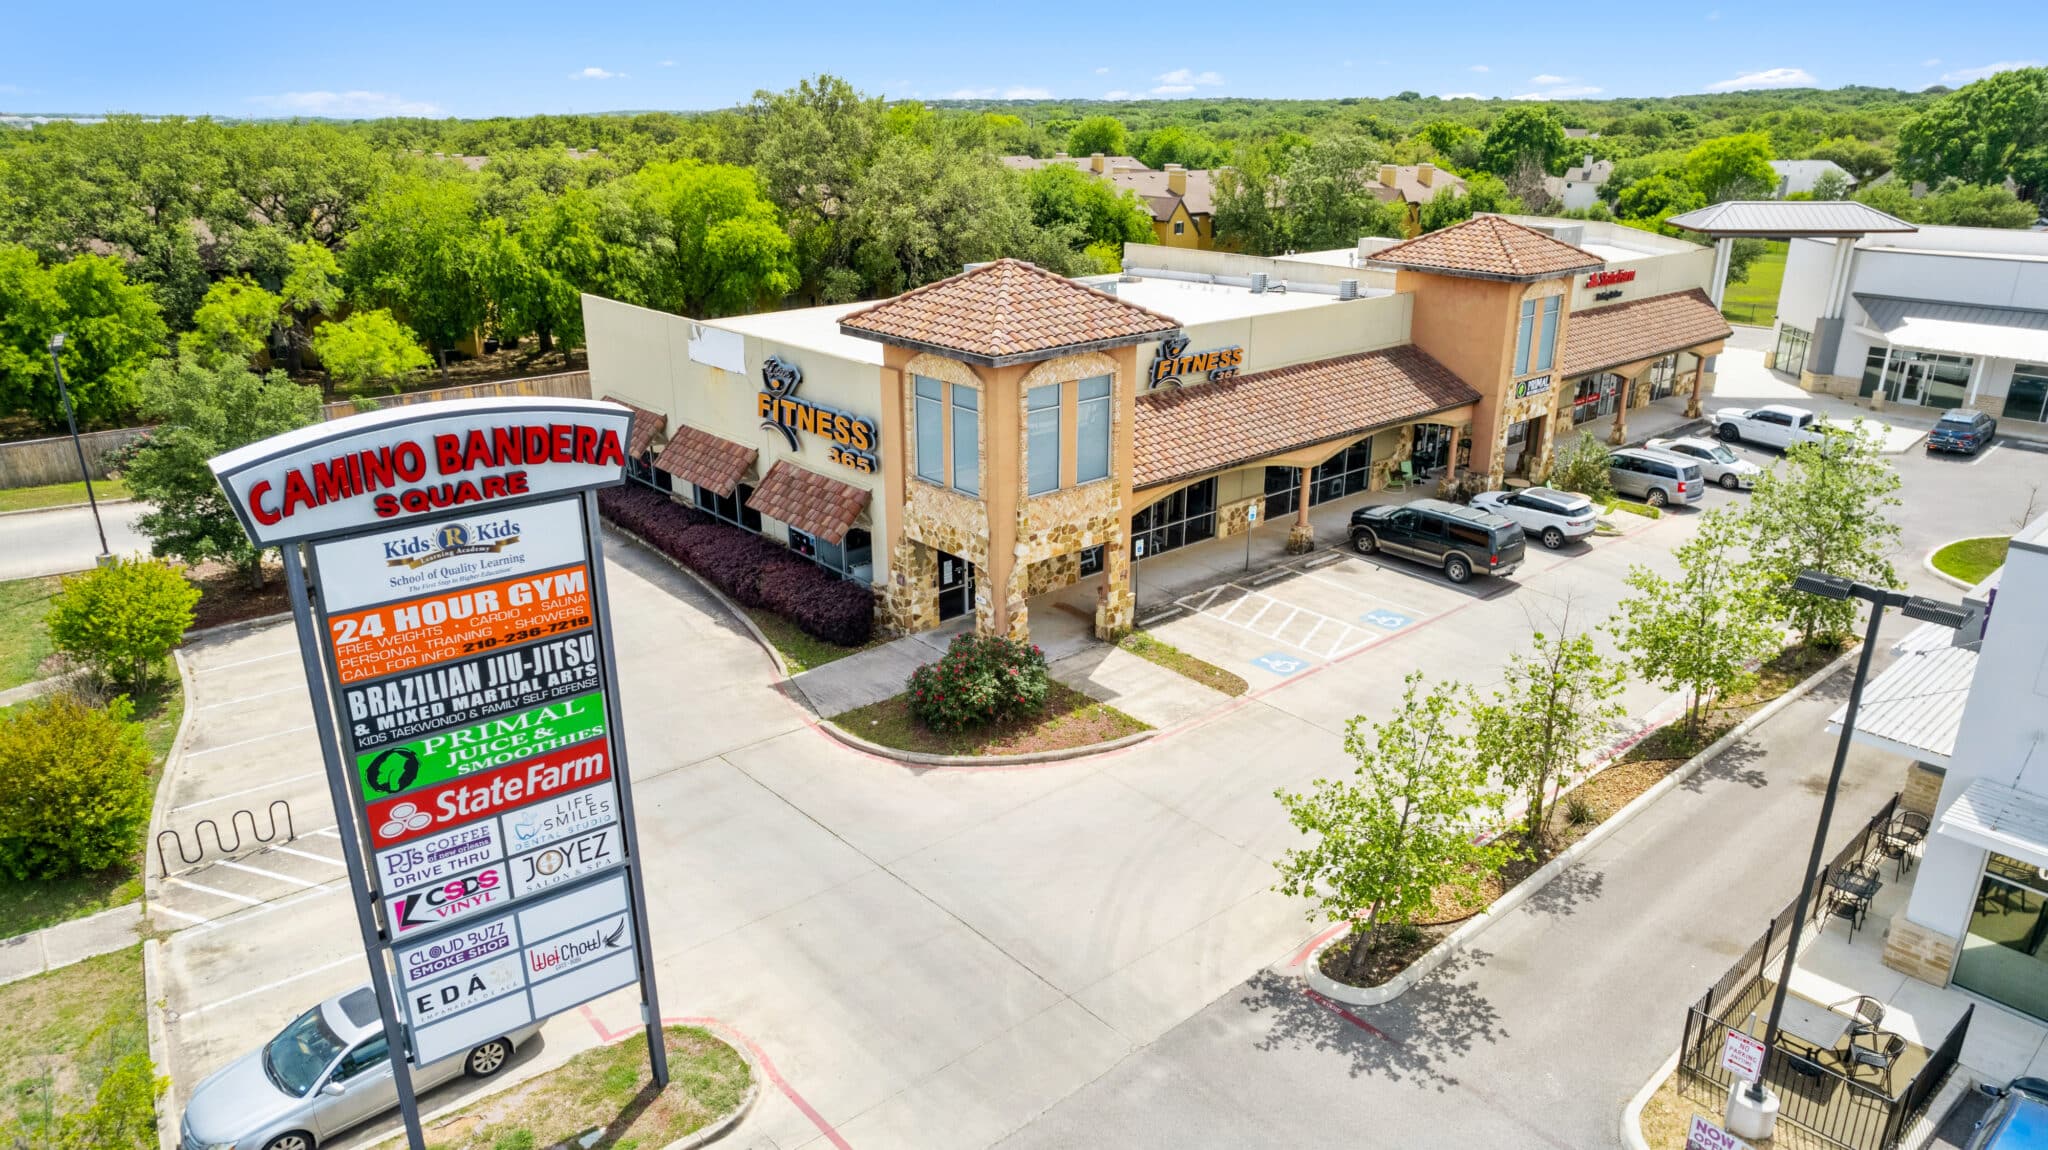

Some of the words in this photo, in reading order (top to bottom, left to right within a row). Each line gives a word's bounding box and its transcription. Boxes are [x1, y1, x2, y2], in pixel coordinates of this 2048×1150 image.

[1157, 347, 1244, 380] FITNESS
[758, 391, 869, 451] FITNESS
[248, 440, 427, 526] CAMINO
[434, 424, 625, 477] BANDERA
[827, 447, 871, 474] 365
[374, 471, 529, 518] SQUARE
[383, 536, 430, 559] Kids
[444, 526, 464, 548] R
[477, 520, 520, 541] Kids
[420, 550, 455, 564] Learning
[389, 571, 425, 588] School
[427, 569, 438, 581] of
[440, 563, 478, 578] Quality
[480, 553, 526, 570] Learning
[333, 613, 385, 645] 24
[393, 590, 500, 633] HOUR
[507, 571, 586, 607] GYM
[337, 641, 374, 657] FREE
[376, 625, 444, 651] WEIGHTS
[469, 608, 521, 628] CARDIO
[541, 594, 587, 612] SAUNA
[340, 643, 424, 669] PERSONAL
[427, 627, 493, 650] TRAINING
[515, 606, 584, 630] SHOWERS
[342, 666, 382, 683] CALL
[386, 657, 417, 672] FOR
[421, 648, 459, 664] INFO:
[462, 616, 590, 654] 210-236-7219
[347, 661, 482, 722] BRAZILIAN
[488, 634, 596, 688] JIU-JITSU
[354, 722, 371, 738] &
[376, 702, 446, 732] MIXED
[453, 679, 542, 712] MARTIAL
[548, 663, 598, 688] ARTS
[358, 732, 388, 748] KIDS
[390, 713, 466, 739] TAEKWONDO
[469, 709, 479, 718] &
[482, 697, 519, 716] FAMILY
[523, 690, 549, 704] SELF
[552, 676, 599, 698] DEFENSE
[421, 699, 586, 757] PRIMAL
[445, 732, 529, 768] JUICE
[533, 727, 557, 739] &
[457, 724, 605, 776] SMOOTHIES
[543, 800, 610, 831] SMILES
[556, 793, 594, 815] LIFE
[384, 848, 424, 876] PJ's
[425, 825, 490, 853] COFFEE
[514, 832, 562, 851] DENTAL
[567, 814, 612, 834] STUDIO
[393, 864, 443, 889] DRIVE
[447, 849, 491, 871] THRU
[428, 854, 438, 863] of
[439, 848, 457, 858] new
[522, 831, 610, 883] JOYEZ
[526, 872, 571, 891] SALON
[586, 858, 612, 870] SPA
[425, 869, 500, 907] CSDS
[435, 891, 497, 918] VINYL
[409, 937, 464, 966] CLOUD
[467, 922, 506, 946] BUZZ
[412, 953, 465, 979] SMOKE
[468, 937, 508, 959] SHOP
[420, 997, 478, 1023] EMPANADAS
[1729, 1046, 1757, 1063] PARKING
[1739, 1042, 1750, 1053] NO
[1696, 1119, 1735, 1150] NOW
